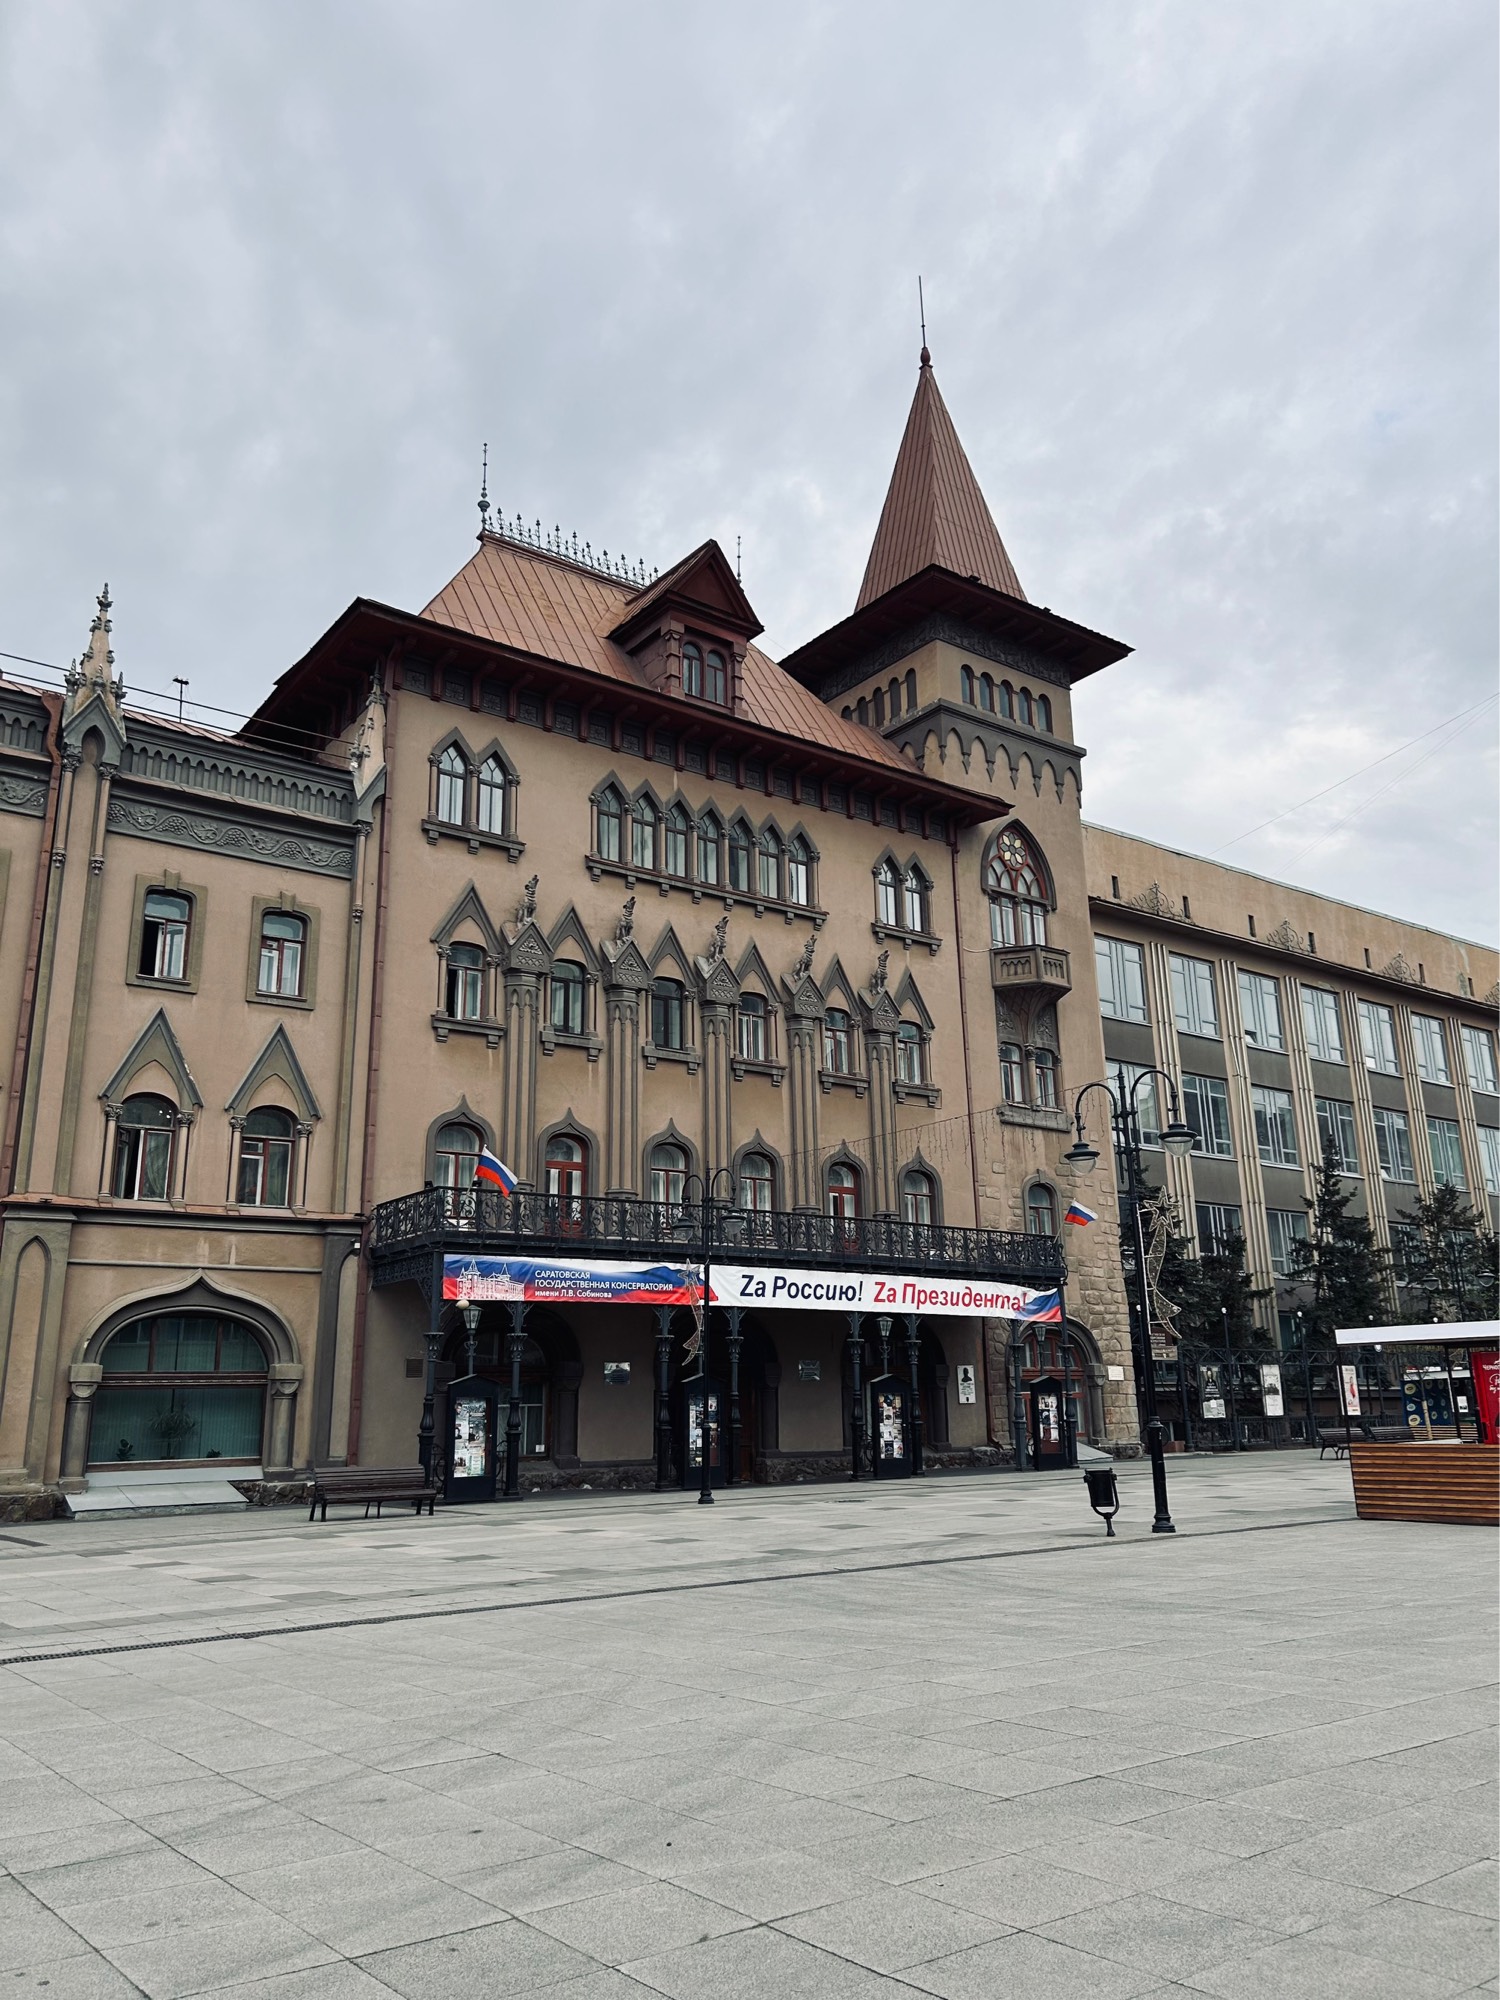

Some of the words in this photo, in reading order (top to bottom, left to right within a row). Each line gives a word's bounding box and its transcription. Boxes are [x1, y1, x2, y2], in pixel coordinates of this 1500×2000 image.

[535, 1270, 590, 1279] САРАТОВСКАЯ
[534, 1279, 610, 1289] ГОСУДАРСТВЕННАЯ
[611, 1281, 673, 1291] КОНСЕРВАТОРИЯ
[560, 1289, 575, 1297] Л.В.
[578, 1289, 612, 1298] Собинова
[772, 1276, 863, 1302] Россию!
[902, 1283, 1028, 1312] Президента!
